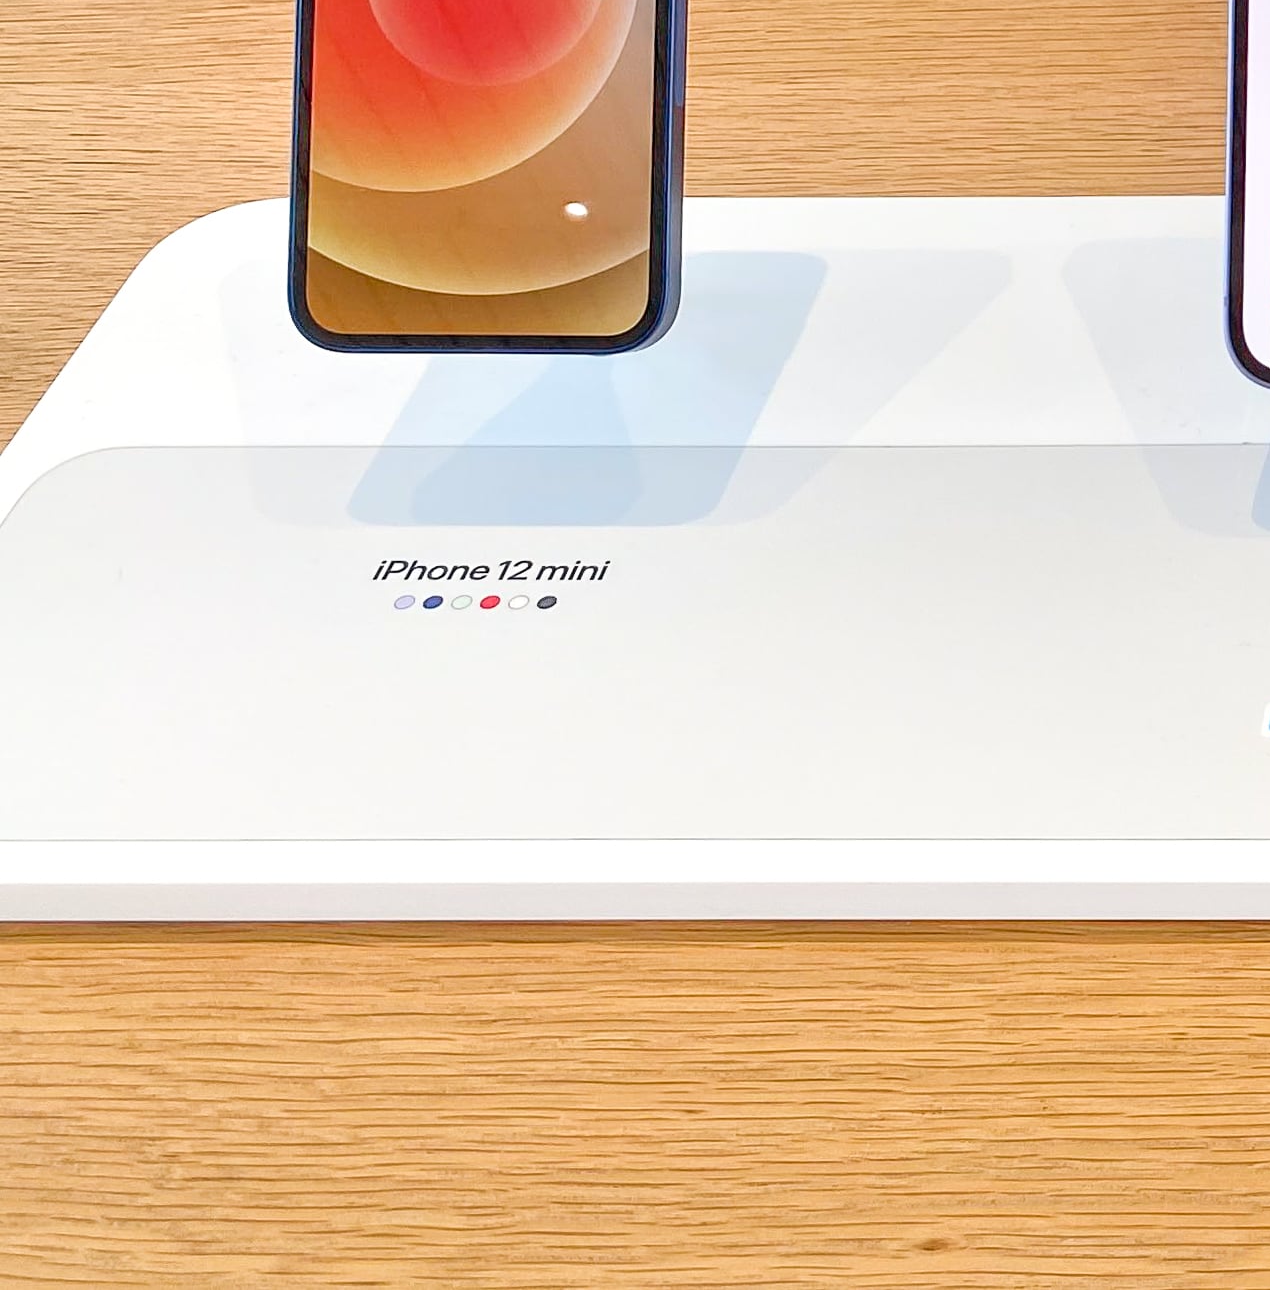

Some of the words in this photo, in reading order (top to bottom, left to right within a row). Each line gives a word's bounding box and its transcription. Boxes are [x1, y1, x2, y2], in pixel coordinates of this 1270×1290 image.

[373, 560, 490, 580] iPhone
[499, 561, 533, 580] 12
[536, 561, 610, 580] mini
